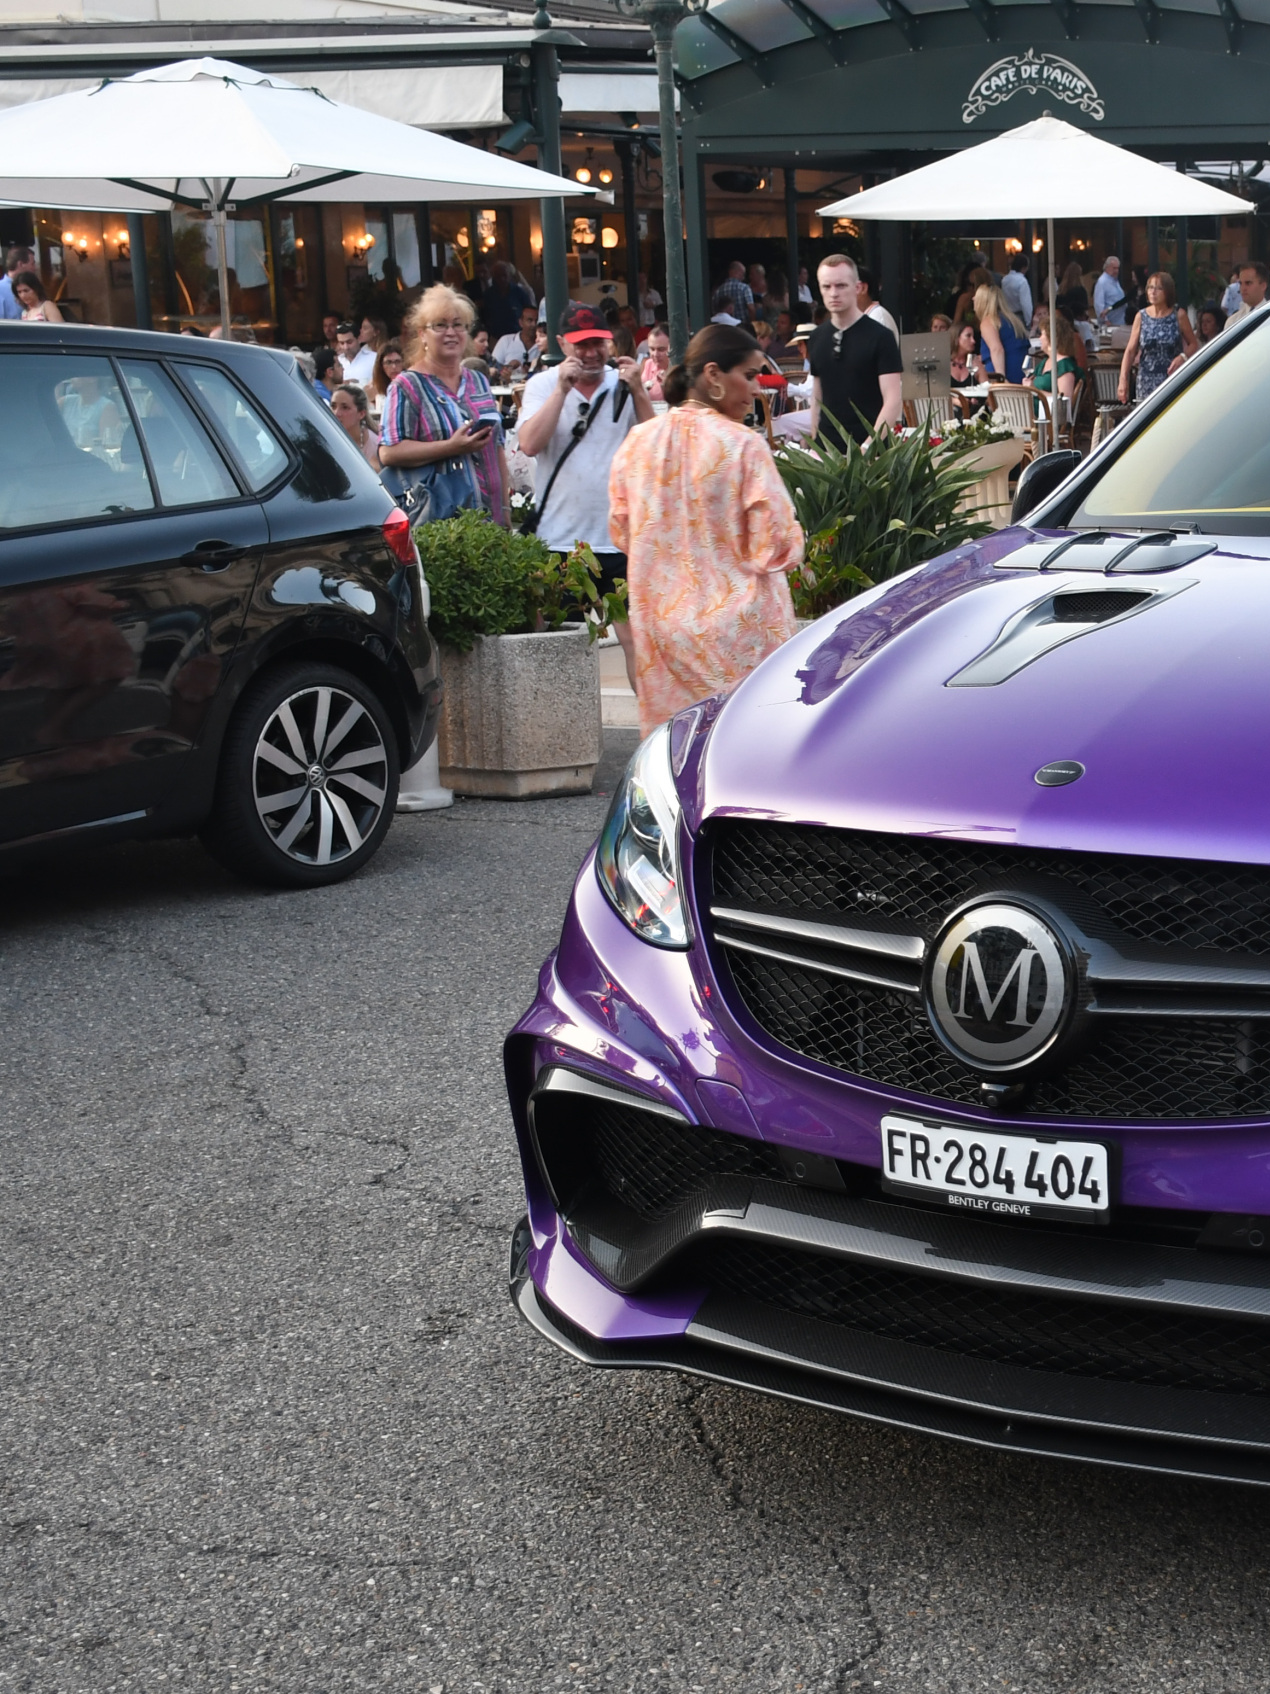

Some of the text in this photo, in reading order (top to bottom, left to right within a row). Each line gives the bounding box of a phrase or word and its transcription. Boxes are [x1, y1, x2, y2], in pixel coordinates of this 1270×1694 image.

[1020, 65, 1040, 78] DE
[1043, 66, 1087, 94] PARIS
[952, 940, 1041, 1028] M
[1024, 1149, 1101, 1204] 404
[948, 1194, 1031, 1216] BENTLEY GENEVE
